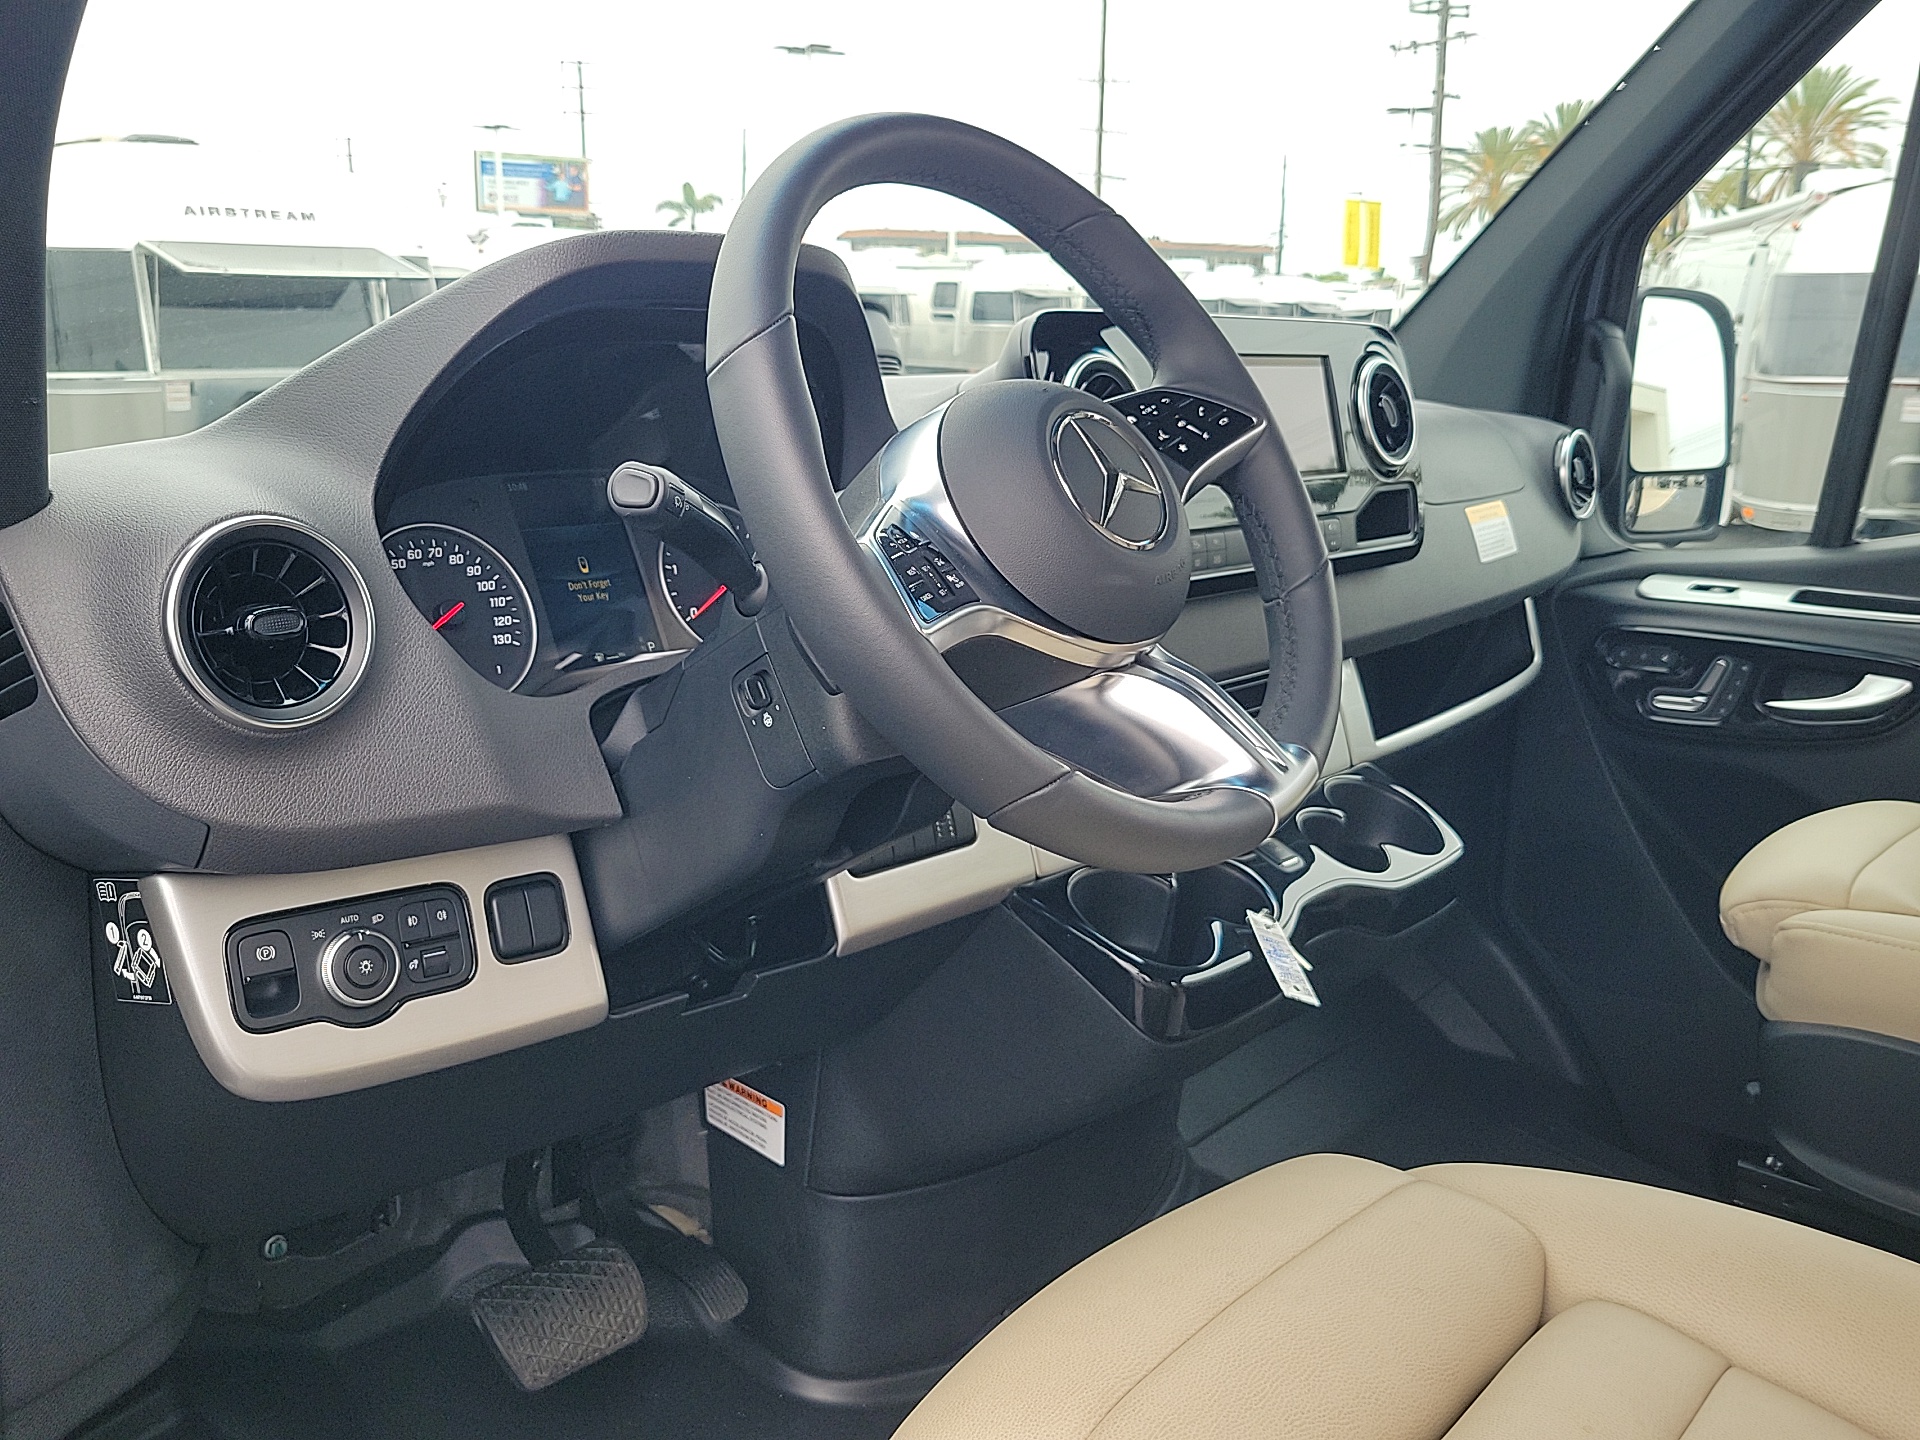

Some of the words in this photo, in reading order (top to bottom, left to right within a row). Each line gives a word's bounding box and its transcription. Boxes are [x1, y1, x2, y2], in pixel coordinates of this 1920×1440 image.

[184, 205, 316, 221] AIRSTREAM
[407, 548, 422, 560] 60
[427, 547, 443, 558] 70
[391, 558, 407, 569] 50
[449, 554, 464, 565] 80
[466, 565, 482, 576] 90
[671, 564, 678, 576] 1
[476, 580, 496, 592] 100
[567, 581, 588, 591] Don't
[588, 578, 612, 589] Forget
[489, 596, 506, 608] 110
[577, 593, 594, 602] Your
[595, 591, 610, 601] Key
[690, 607, 698, 619] 0
[493, 615, 512, 627] 120
[492, 634, 512, 645] 130
[647, 641, 656, 651] P
[496, 665, 502, 675] 1
[340, 914, 360, 924] AUTO
[729, 1082, 768, 1108] WARNING
